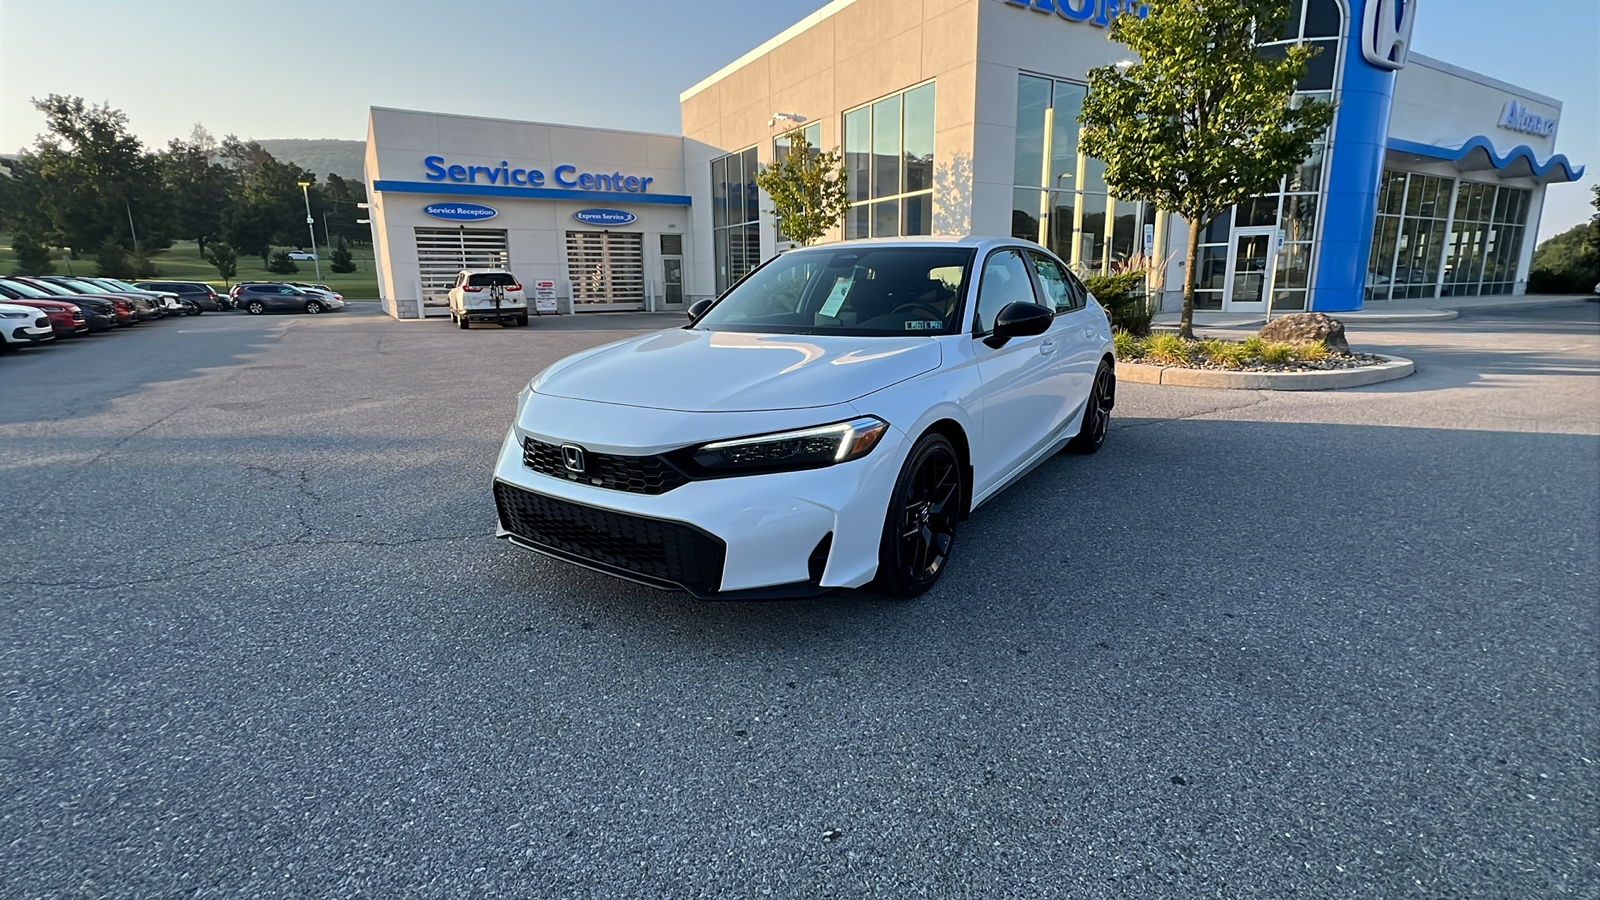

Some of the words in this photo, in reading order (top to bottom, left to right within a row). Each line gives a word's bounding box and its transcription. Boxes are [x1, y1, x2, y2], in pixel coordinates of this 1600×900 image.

[424, 155, 545, 187] Service
[554, 164, 653, 192] Center
[427, 206, 456, 214] Service
[457, 207, 494, 216] Reception
[578, 212, 601, 220] Express
